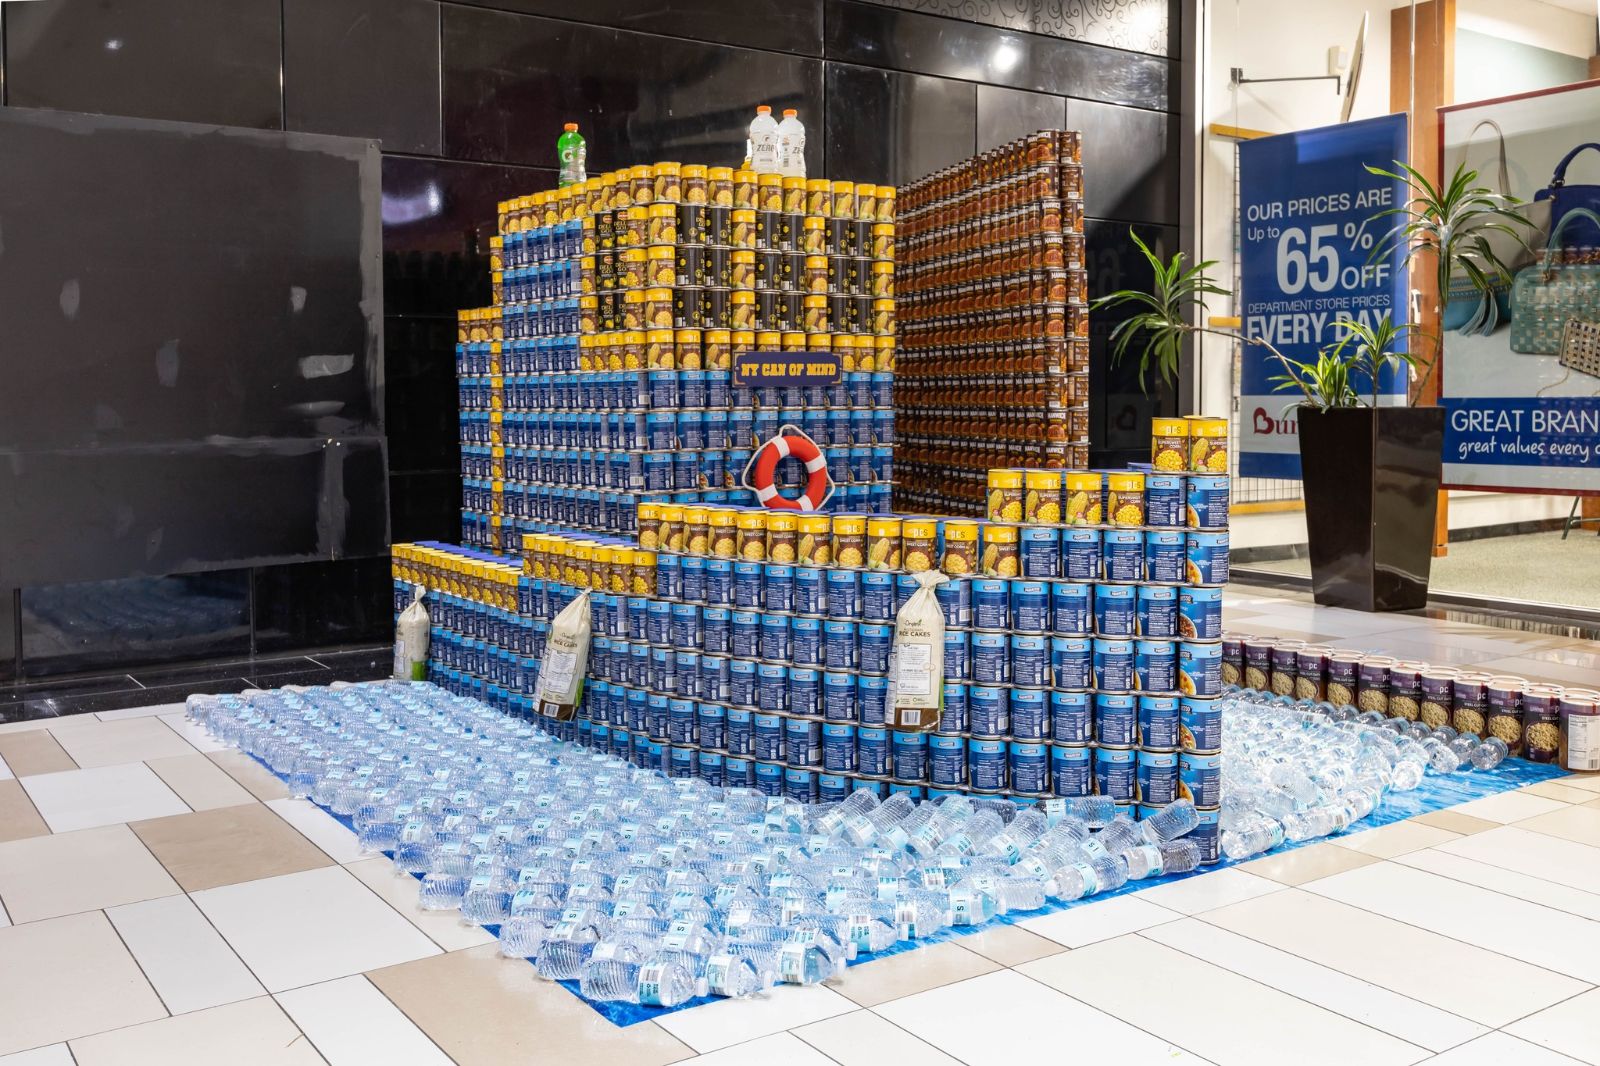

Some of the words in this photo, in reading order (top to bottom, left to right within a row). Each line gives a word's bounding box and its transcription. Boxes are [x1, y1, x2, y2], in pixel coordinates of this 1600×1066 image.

[1247, 202, 1283, 222] OUR
[1288, 193, 1350, 217] PRICES
[1354, 187, 1392, 208] ARE
[1247, 227, 1264, 242] Up
[1267, 226, 1280, 238] to
[1340, 264, 1390, 290] OFF
[1248, 300, 1312, 314] DEPARTMENT
[1316, 297, 1350, 310] STORE
[1352, 294, 1390, 308] PRICES
[1247, 312, 1328, 346] EVERY
[741, 364, 759, 376] NY
[762, 364, 786, 376] CAN
[788, 364, 804, 376] OF
[806, 363, 837, 376] MIND
[1451, 410, 1524, 432] GREAT
[1532, 410, 1600, 433] BRAN
[1459, 435, 1497, 460] great
[1500, 434, 1546, 456] values
[1550, 442, 1590, 463] every
